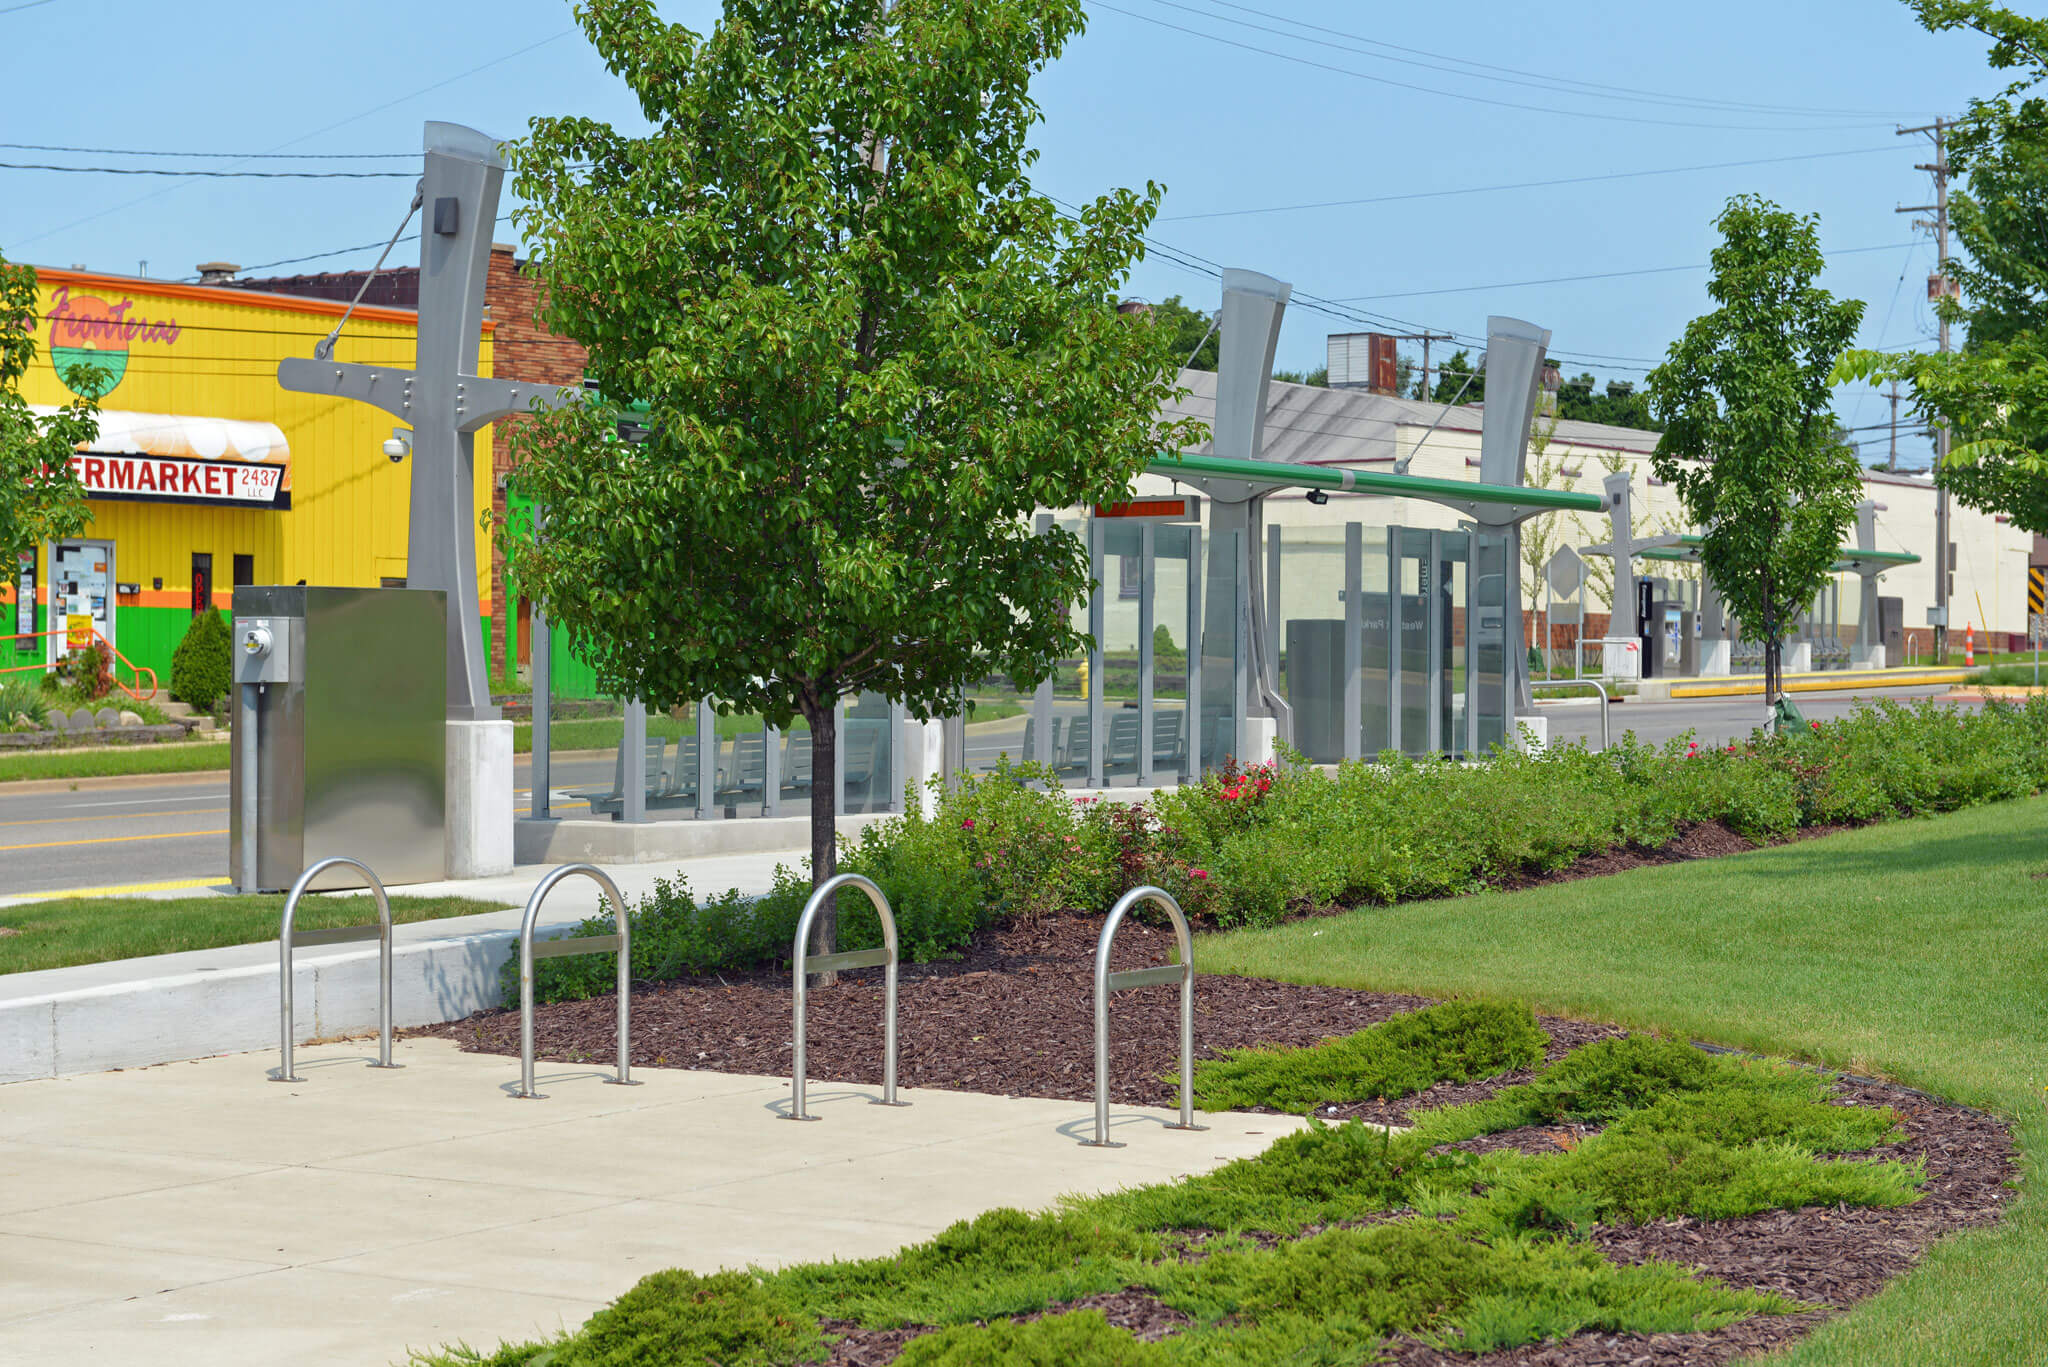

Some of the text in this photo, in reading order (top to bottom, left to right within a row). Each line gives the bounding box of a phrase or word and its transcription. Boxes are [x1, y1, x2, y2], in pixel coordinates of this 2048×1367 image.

[47, 286, 182, 347] Fronteras
[23, 457, 278, 496] ERMARKET 2437
[247, 487, 265, 498] LLC
